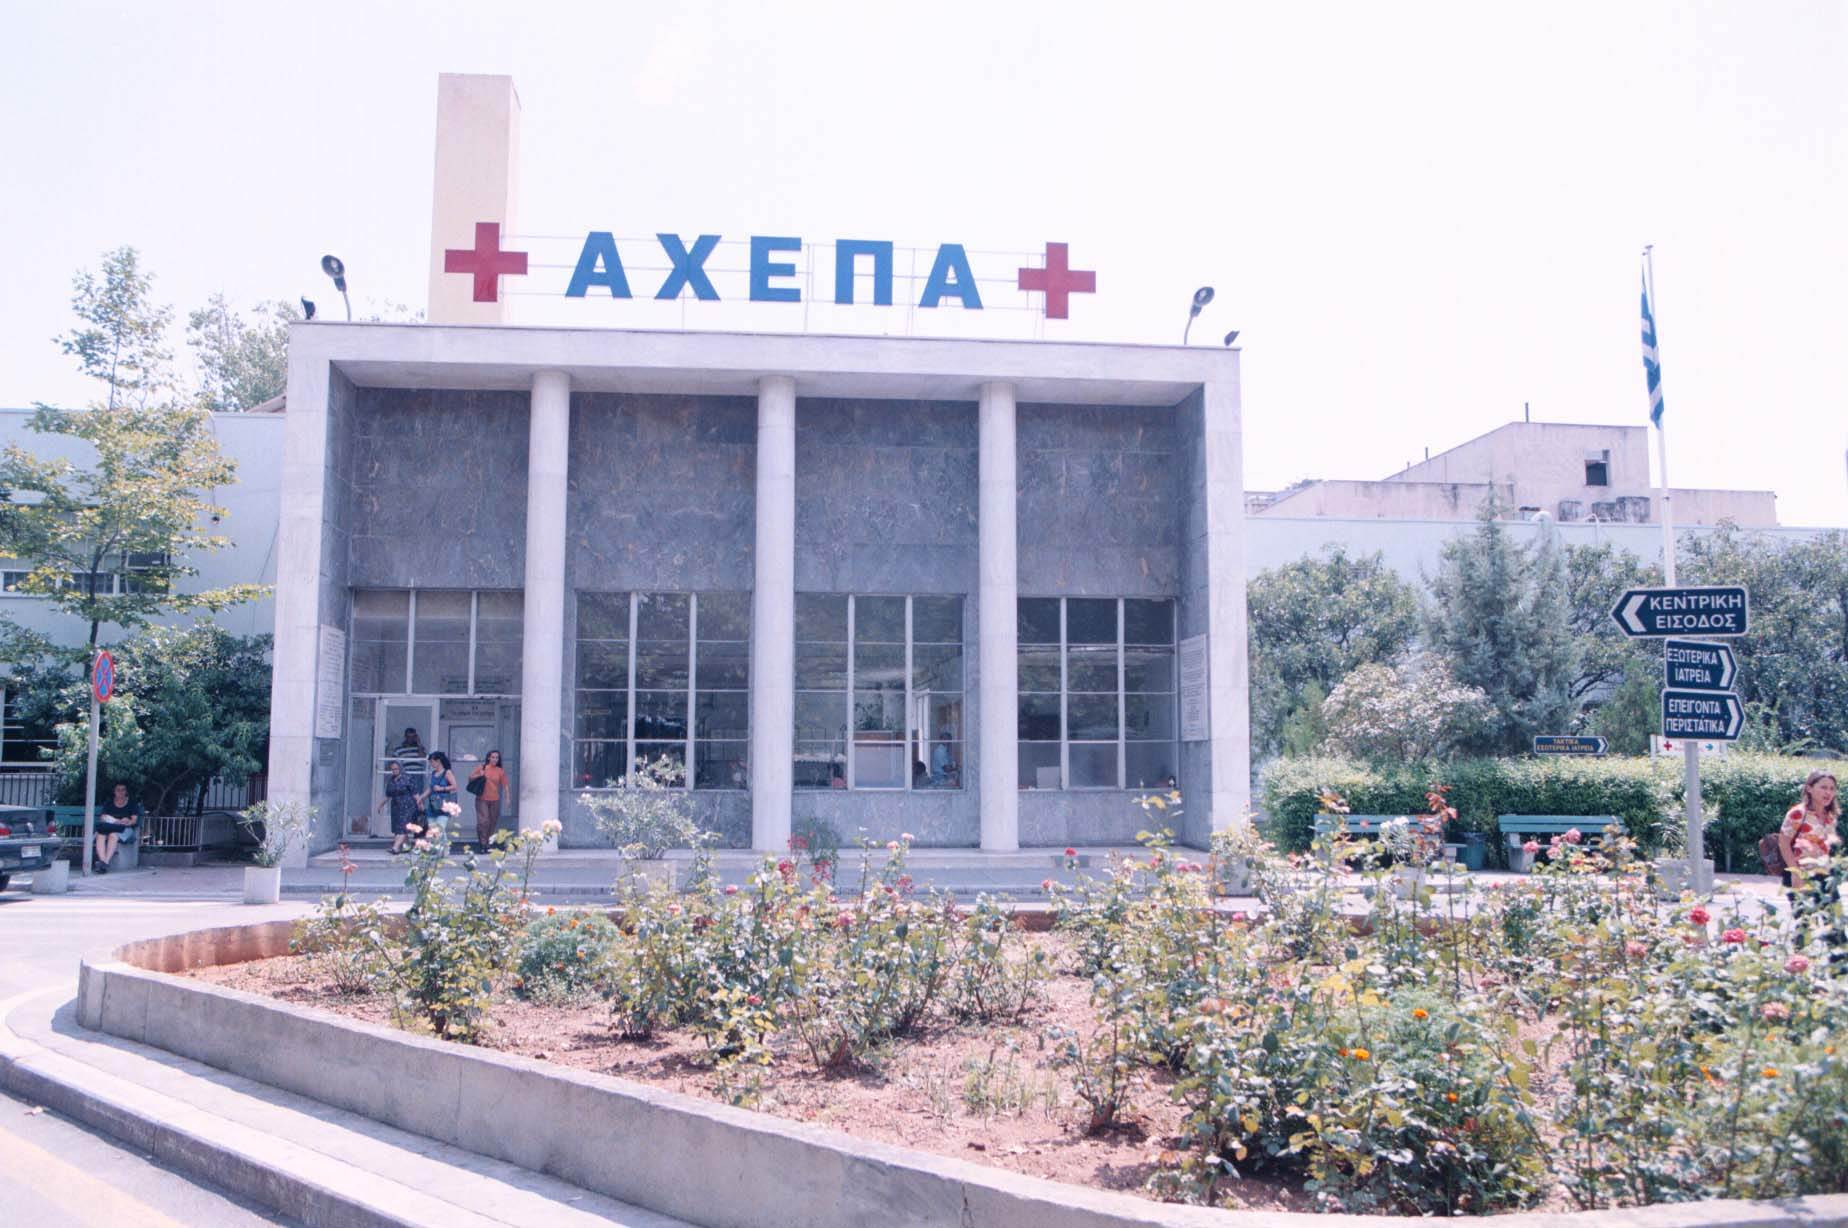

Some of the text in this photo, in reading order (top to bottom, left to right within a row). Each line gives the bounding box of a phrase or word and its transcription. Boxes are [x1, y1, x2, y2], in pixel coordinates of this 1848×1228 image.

[565, 231, 984, 310] ΑΧΕΠΑ
[1650, 594, 1742, 610] ΚΕΝΤΡΙΚΗ
[1655, 613, 1736, 629] ΕΙΣΟΔΟΣ
[1667, 648, 1718, 665] ΕΞΩΤΕΡΙΚΑ
[1674, 668, 1711, 683] ΙΑΤΡΕΙΑ
[1668, 699, 1720, 714] ΕΠΕΙΓΟΝΤΑ
[1666, 718, 1725, 733] ΠΕΡΙΣΤΑΤΙΚΑ
